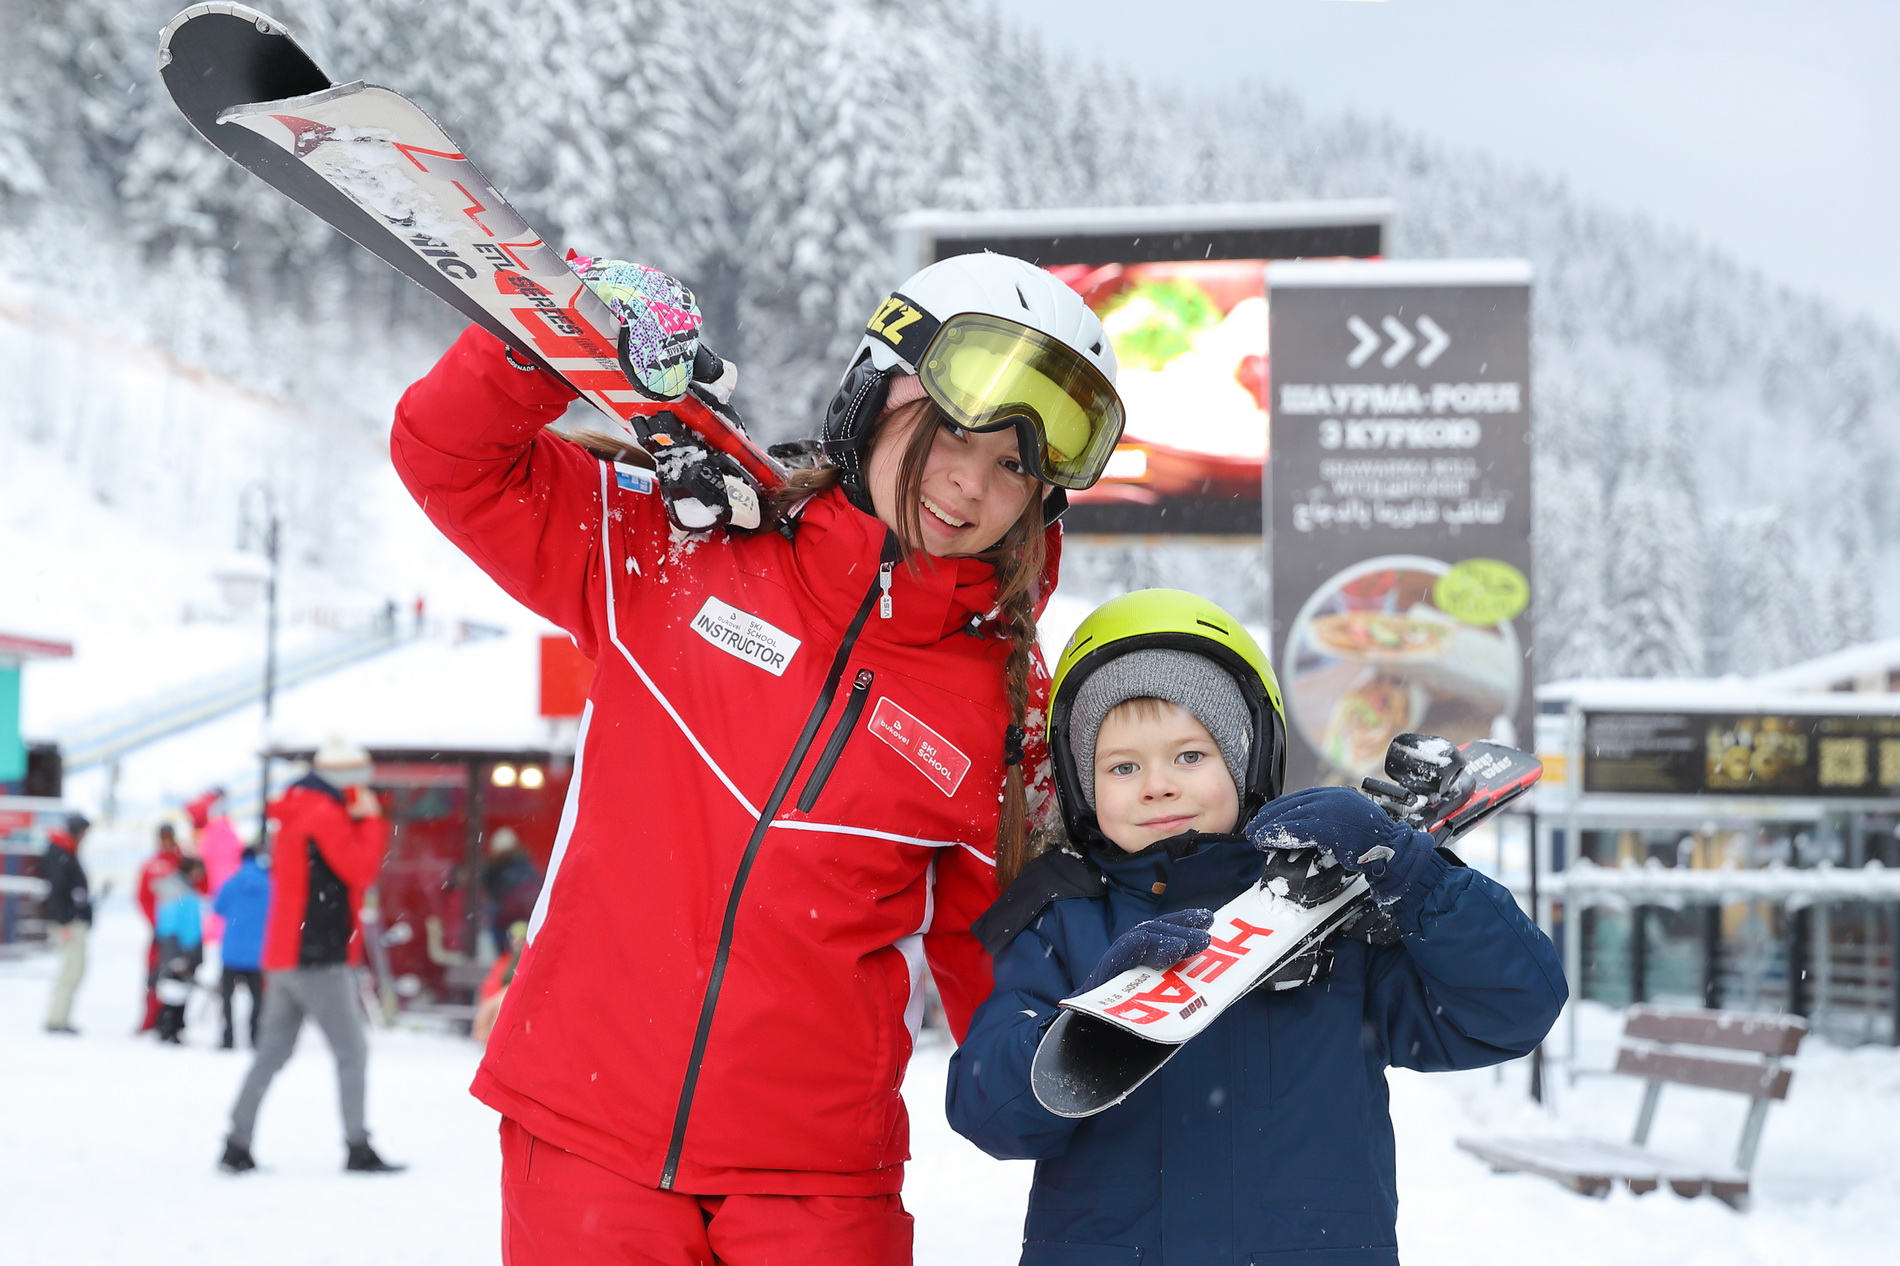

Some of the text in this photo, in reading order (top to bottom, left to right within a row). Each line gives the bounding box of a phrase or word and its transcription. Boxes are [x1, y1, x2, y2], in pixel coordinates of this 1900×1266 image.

[471, 243, 516, 273] ETL
[507, 275, 584, 336] SERIES
[506, 355, 536, 372] GRENADE
[1280, 383, 1520, 414] ШАУРМА-РОЛЛ
[1345, 418, 1481, 449] КУРКОЮ
[717, 615, 742, 631] bukovel
[749, 621, 763, 631] SKI
[697, 614, 785, 669] INSTRUCTOR
[746, 628, 777, 648] SCHOOL
[880, 718, 910, 746] bukovel
[920, 740, 937, 757] SKI
[917, 748, 953, 781] SCHOOL
[1463, 752, 1494, 776] shape
[1103, 917, 1274, 1025] HEAD
[1178, 995, 1209, 1020] team
